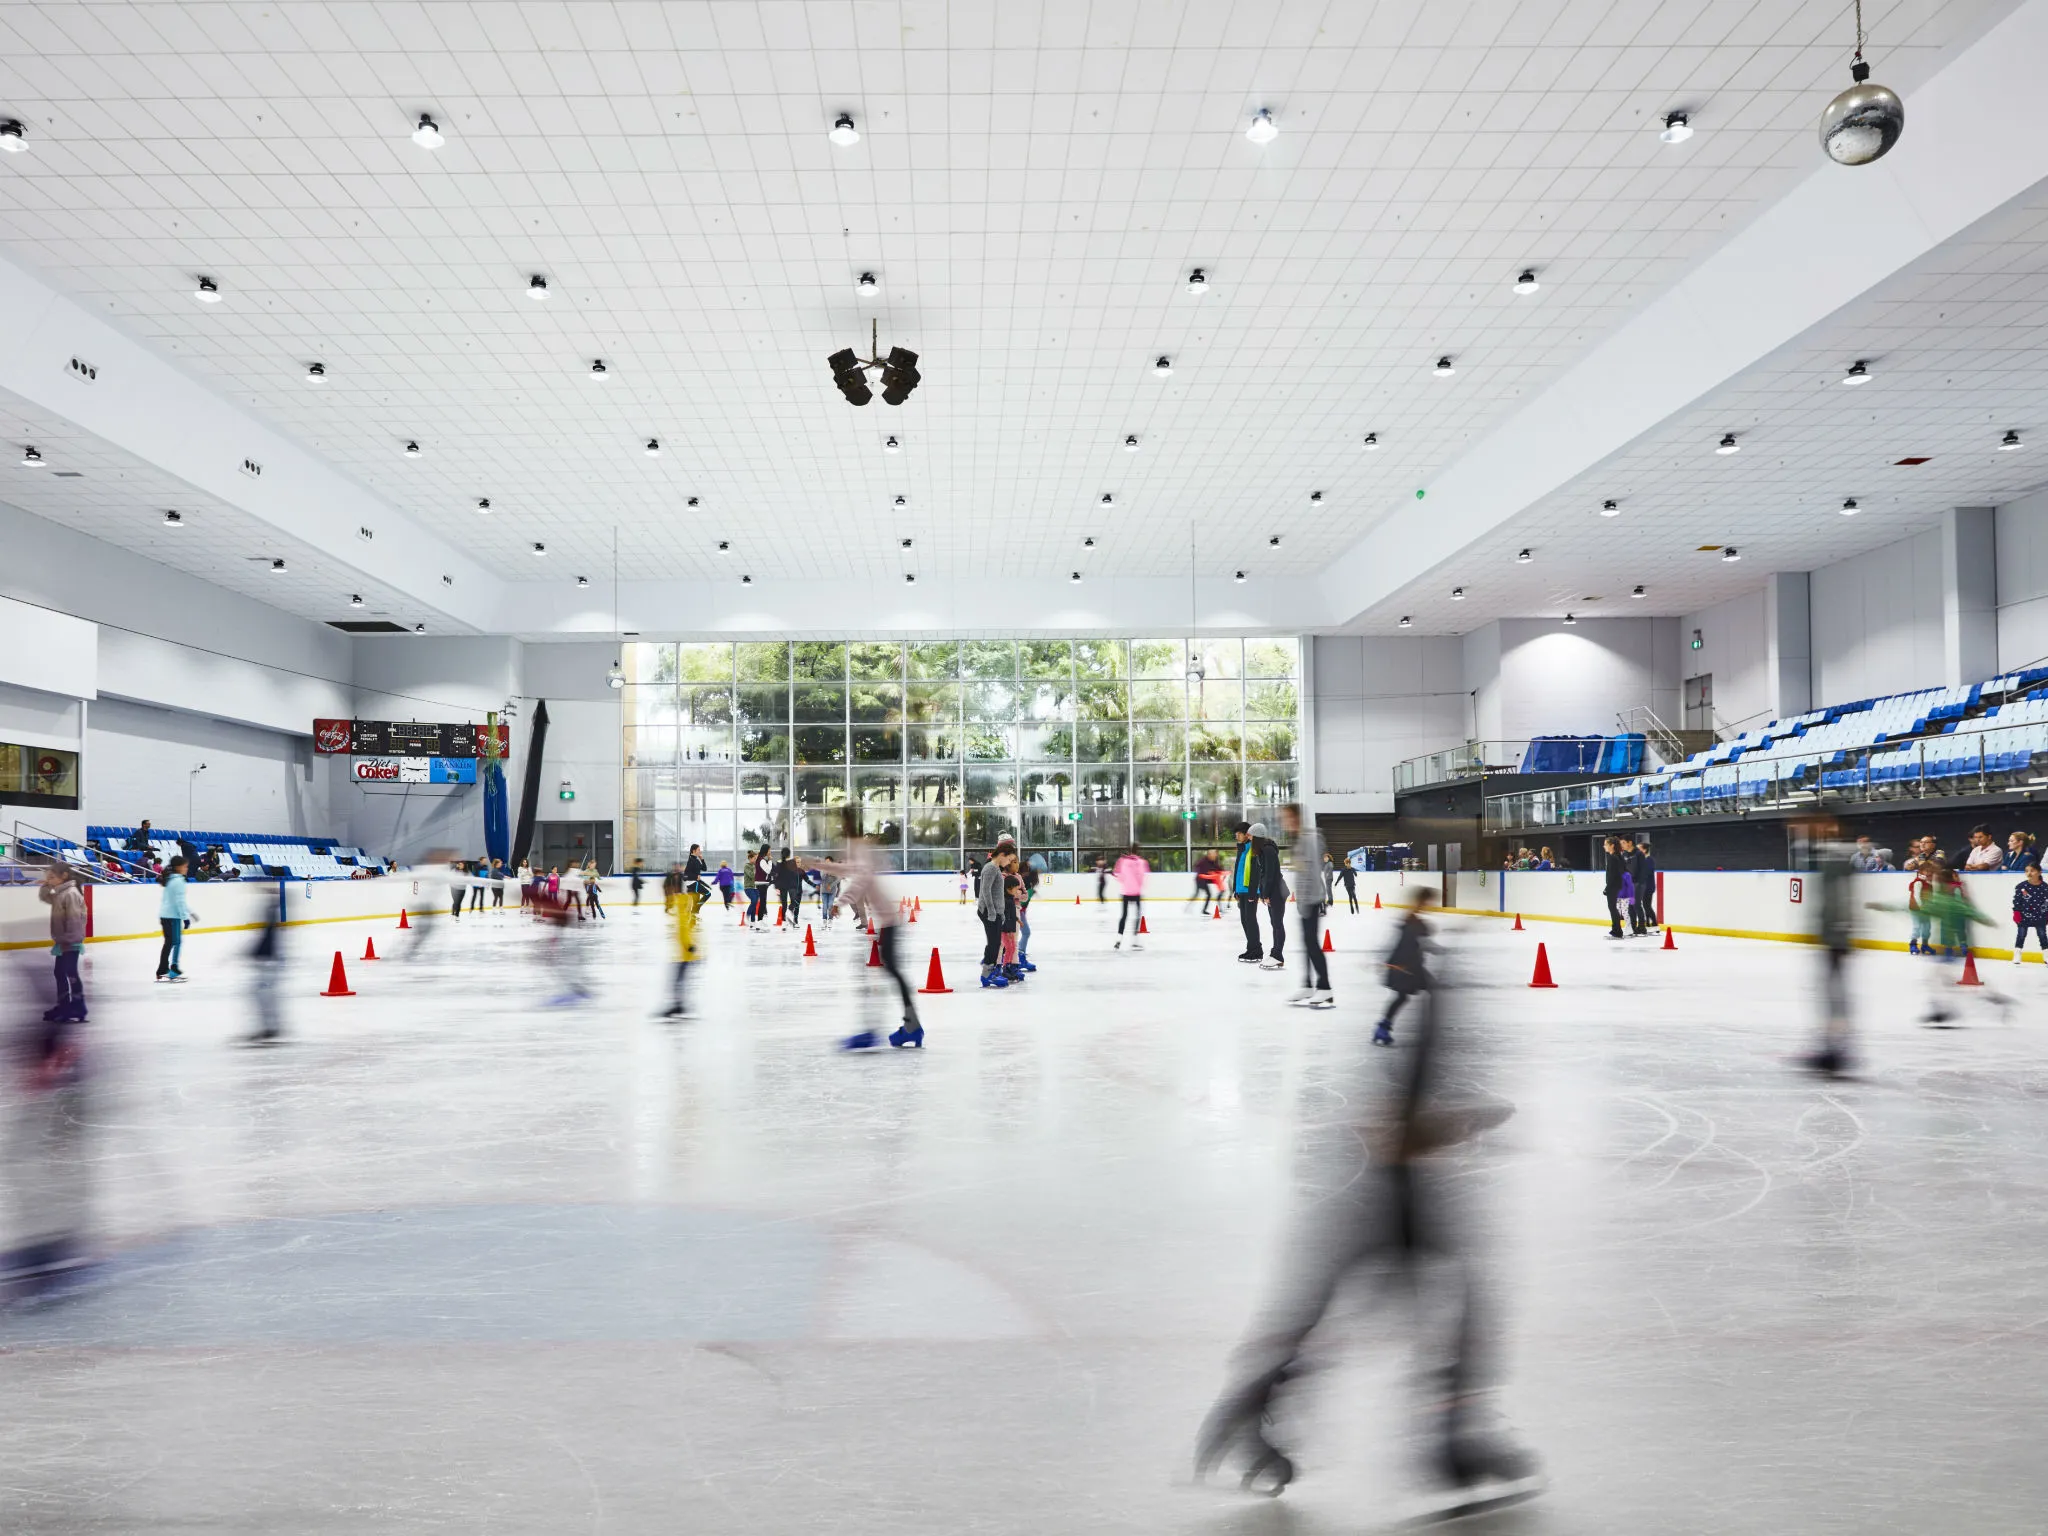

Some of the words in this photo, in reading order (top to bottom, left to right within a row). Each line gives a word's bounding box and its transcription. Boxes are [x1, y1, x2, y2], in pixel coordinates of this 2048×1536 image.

[367, 757, 391, 768] Diet
[357, 764, 392, 779] Coke
[1792, 883, 1799, 898] 9
